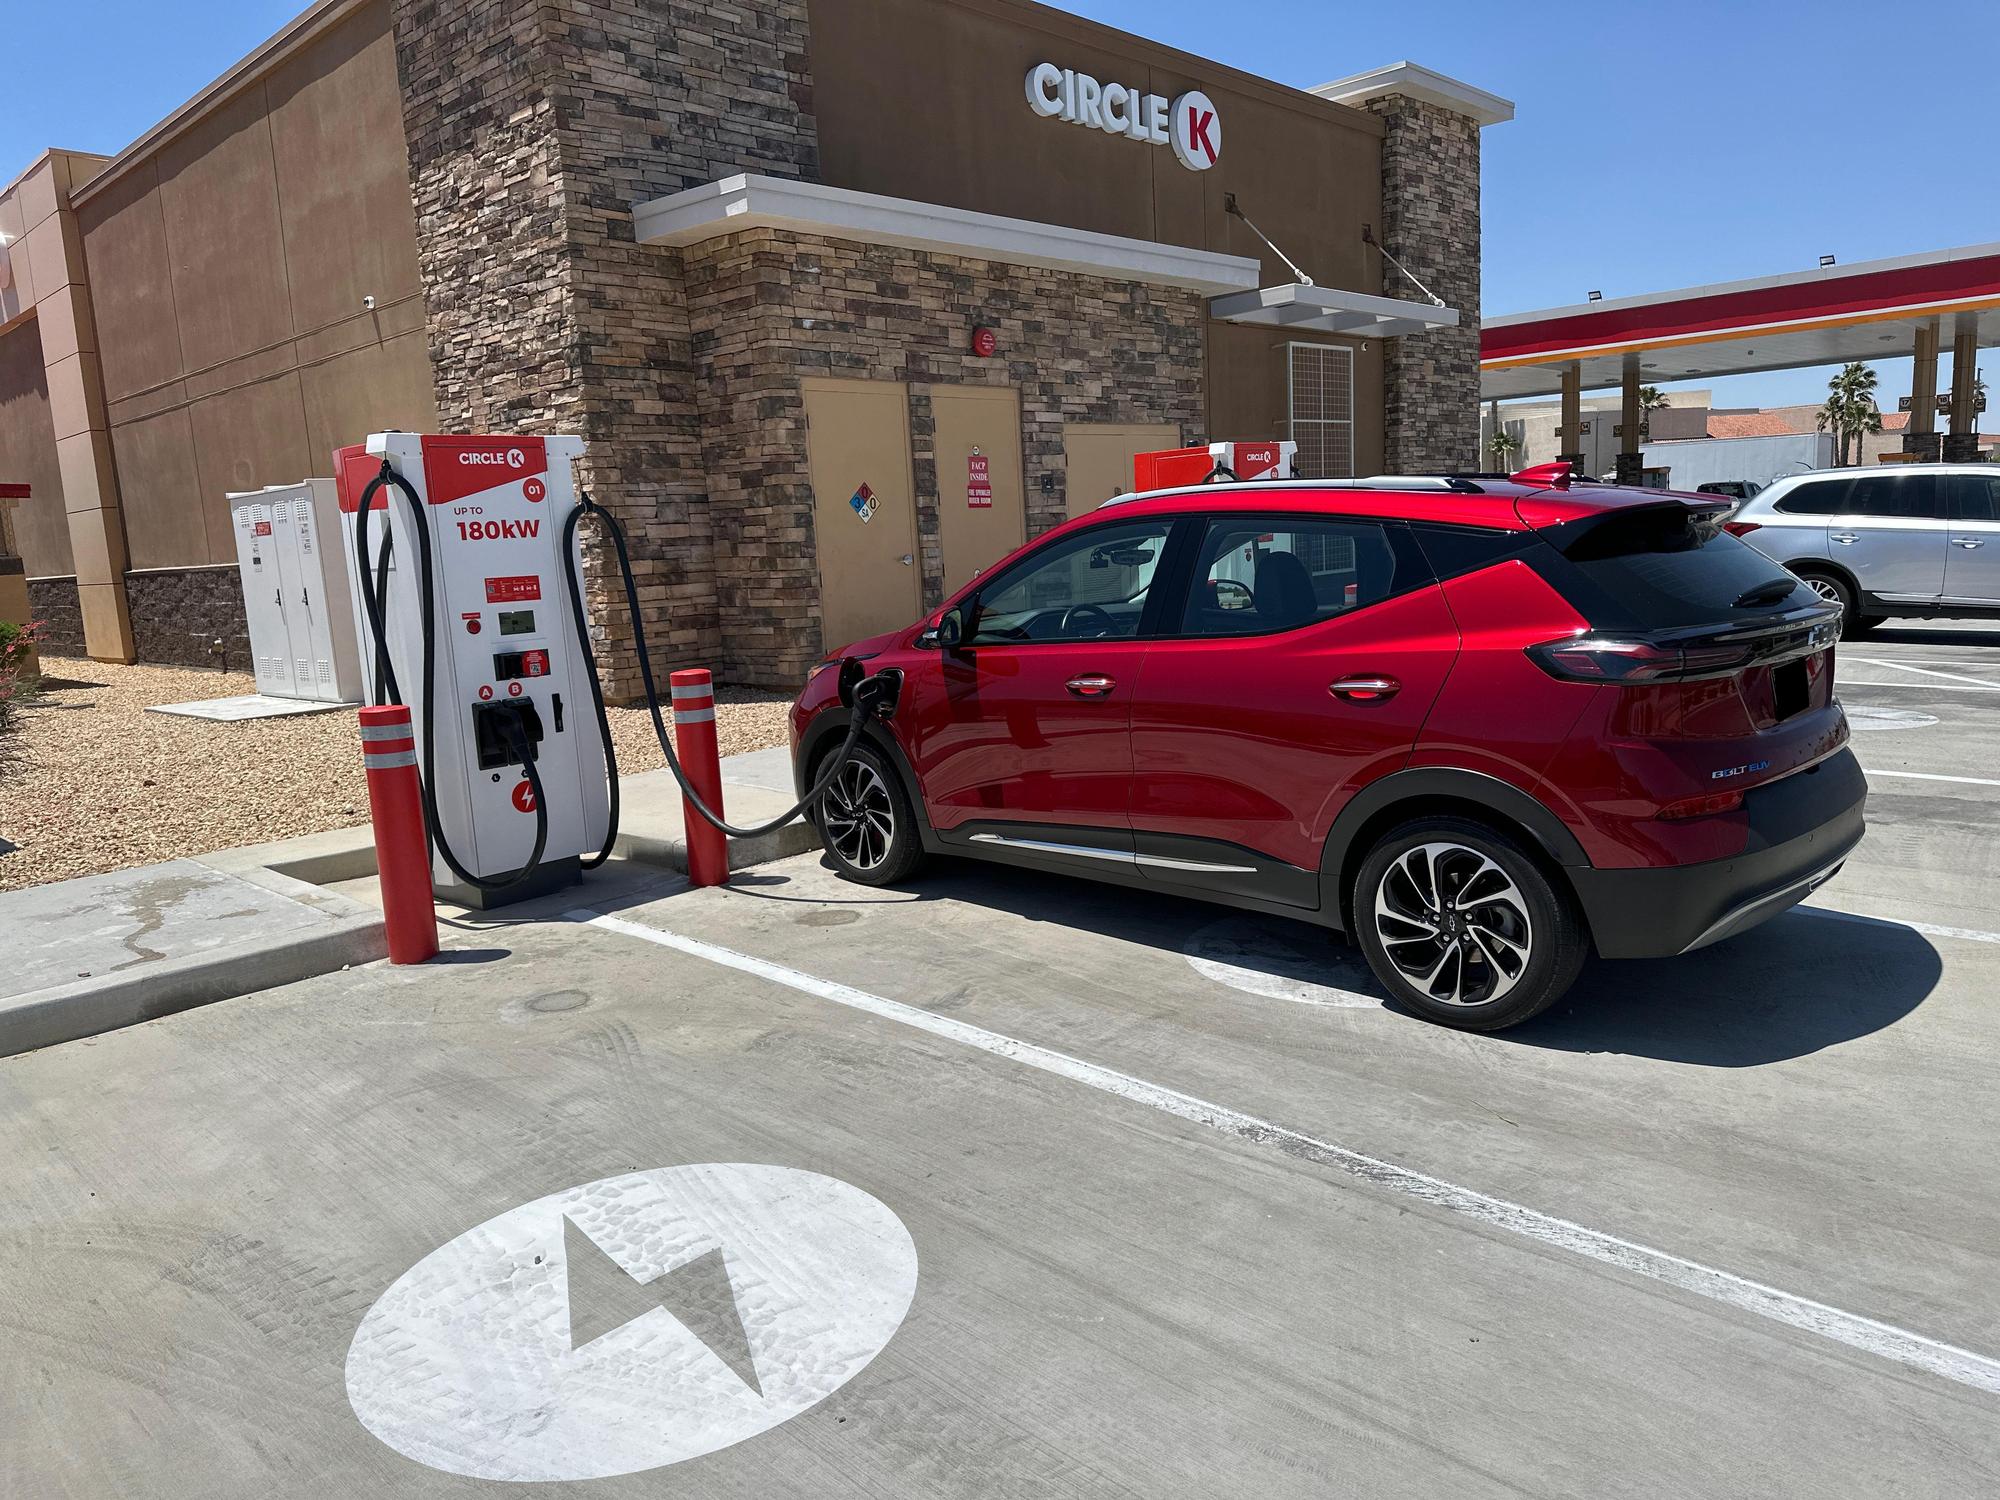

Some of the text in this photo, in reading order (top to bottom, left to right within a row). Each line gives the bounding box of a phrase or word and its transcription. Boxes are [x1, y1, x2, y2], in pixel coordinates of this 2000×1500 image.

[1025, 62, 1169, 145] CIRCLE
[459, 453, 505, 465] CIRCLE
[971, 461, 986, 470] FACP
[969, 472, 988, 481] INSIDE
[528, 485, 541, 495] 01
[861, 486, 868, 499] 0
[854, 496, 876, 510] 3 0
[454, 506, 483, 515] UP TO
[456, 519, 540, 541] 180kW
[482, 688, 491, 697] A
[511, 684, 520, 694] B
[1711, 759, 1770, 779] BOLT EUV
